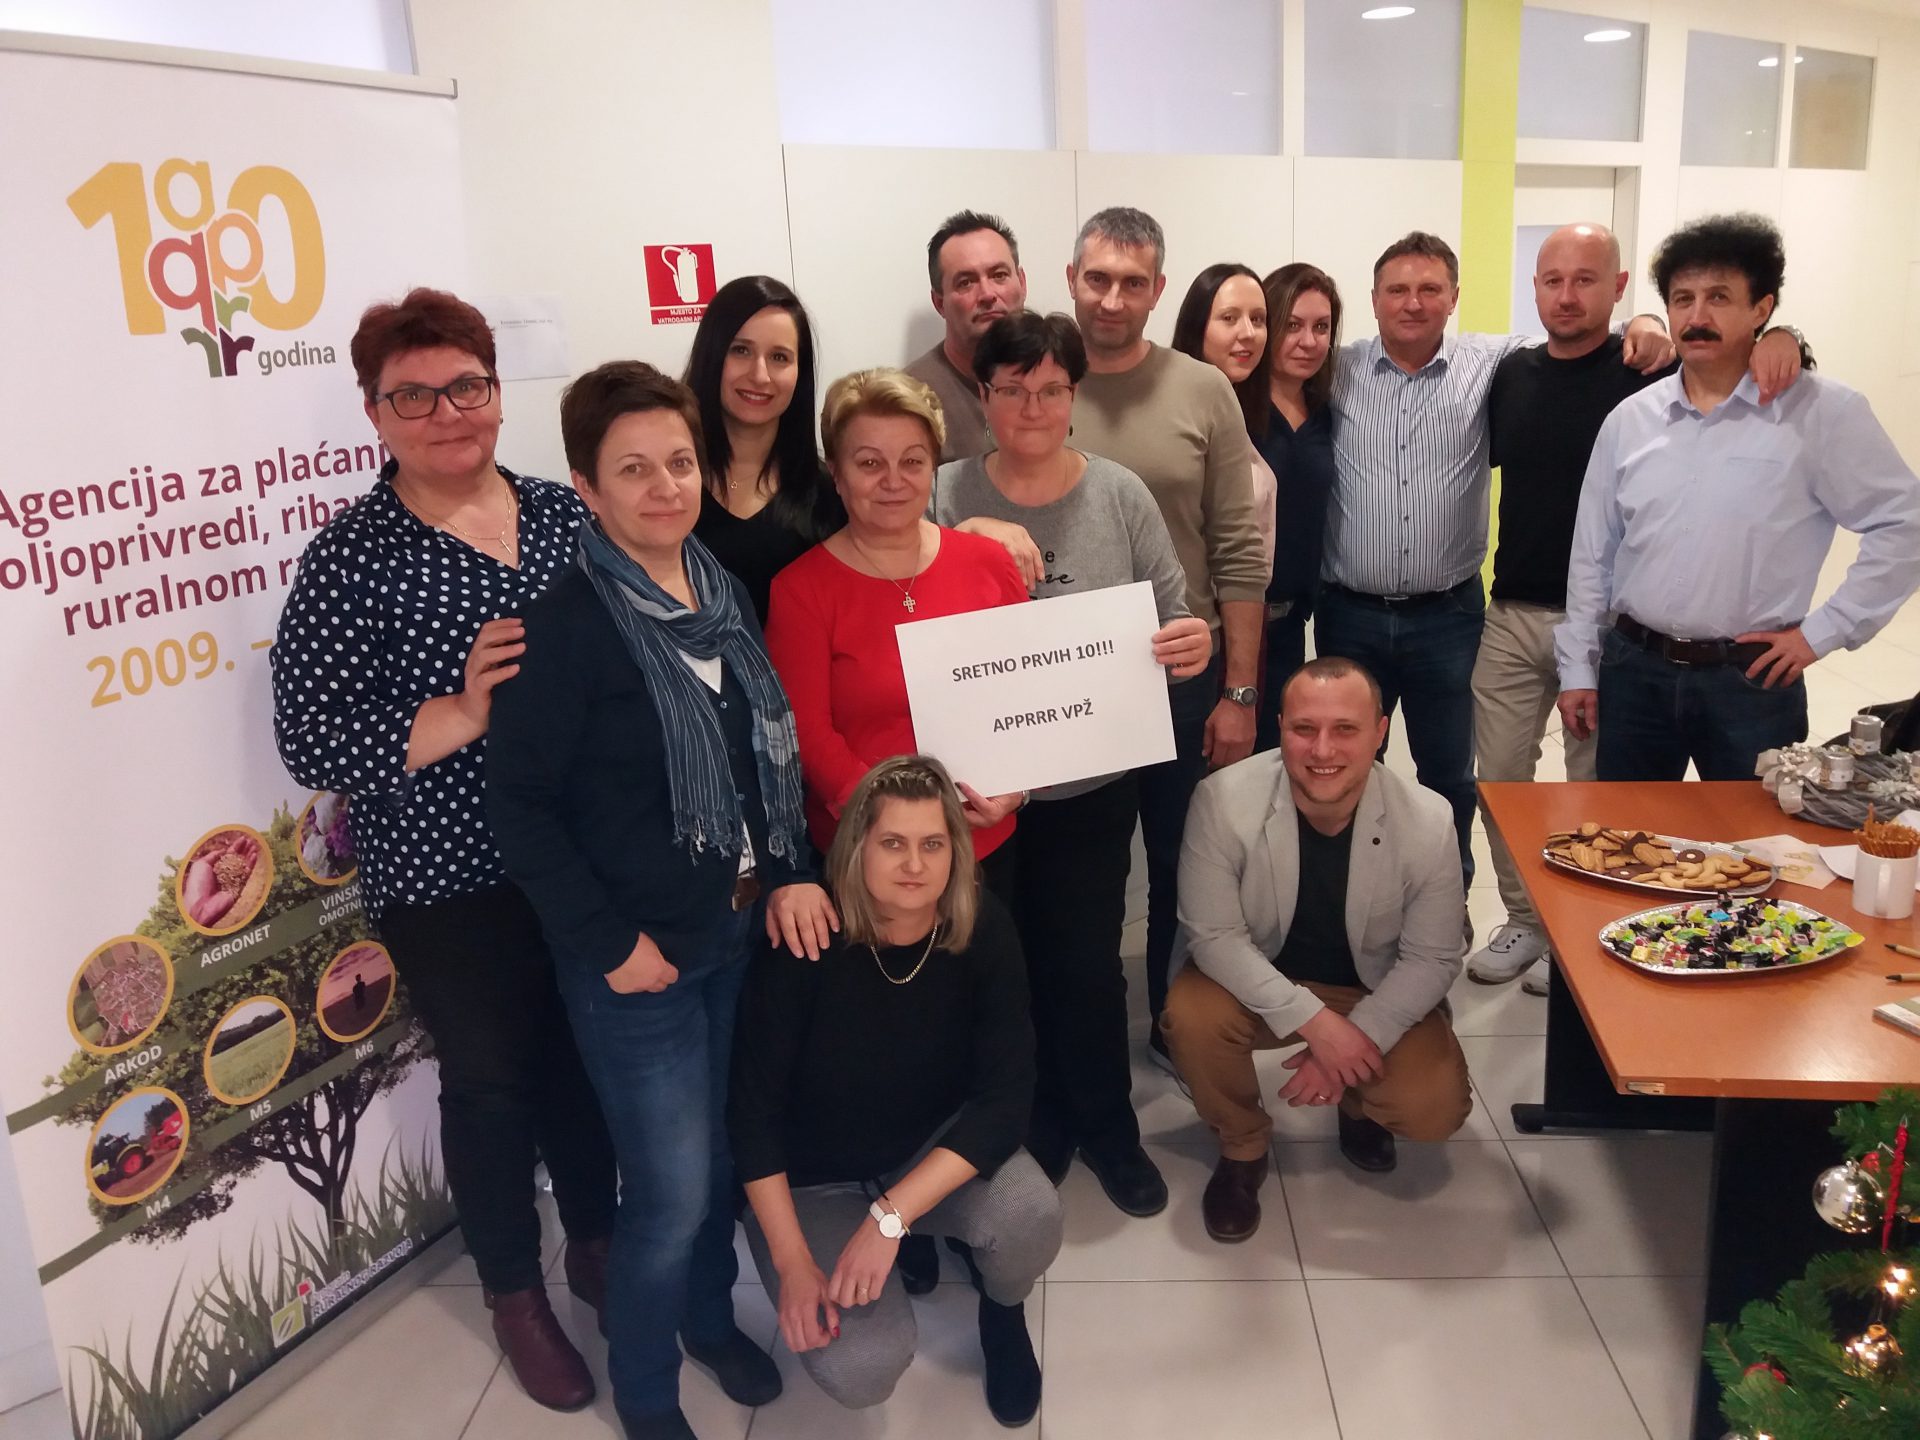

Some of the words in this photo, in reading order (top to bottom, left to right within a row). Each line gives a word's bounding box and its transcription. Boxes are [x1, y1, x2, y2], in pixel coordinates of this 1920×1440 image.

[257, 341, 336, 376] godina
[0, 465, 186, 539] Agencija
[198, 464, 242, 497] za
[255, 435, 388, 499] plaćanj
[0, 504, 270, 596] oljoprivredi,
[63, 564, 267, 636] ruralnom
[86, 631, 235, 708] 2009.
[952, 658, 1017, 682] SRETNO
[1021, 648, 1072, 670] PRVIH
[1075, 639, 1115, 660] 10!!!
[993, 708, 1059, 733] APPRRR
[1061, 698, 1094, 720] VPŽ
[318, 898, 362, 926] OMOTNI
[321, 882, 362, 911] VINSK
[200, 924, 271, 969] AGRONET
[104, 1045, 162, 1085] ARKOD
[355, 1040, 374, 1060] M6
[249, 1099, 272, 1121] M5
[145, 1194, 172, 1219] M4
